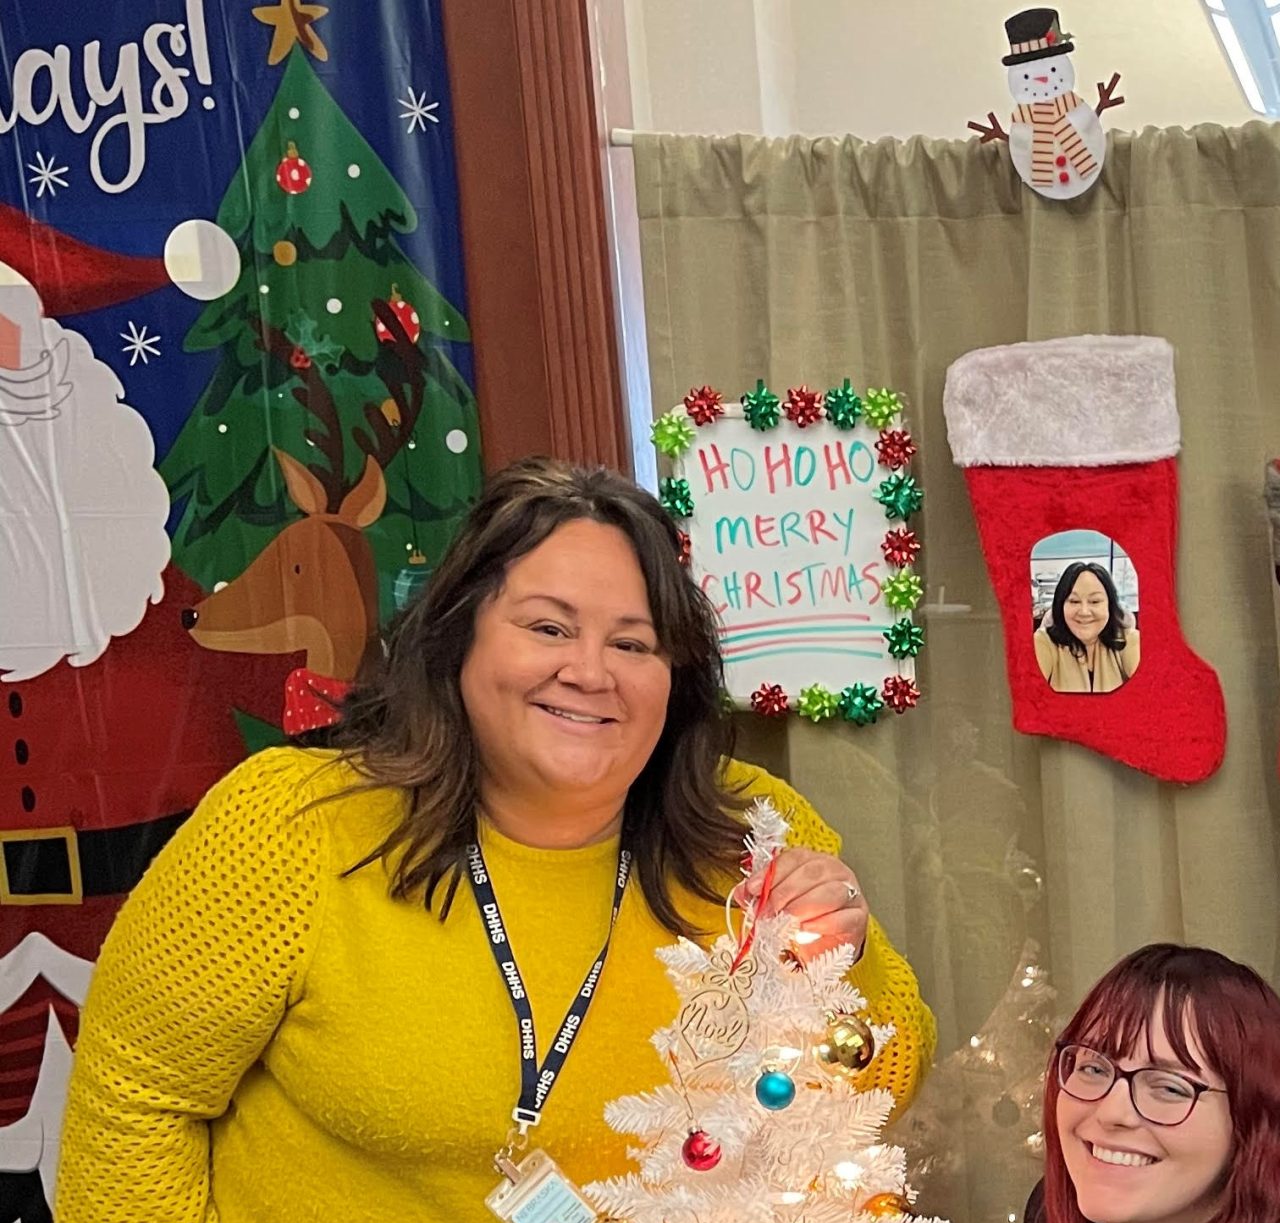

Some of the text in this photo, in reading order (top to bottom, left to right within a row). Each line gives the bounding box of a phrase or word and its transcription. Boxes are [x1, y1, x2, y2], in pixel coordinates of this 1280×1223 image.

[0, 0, 216, 194] ays!
[715, 508, 854, 556] MERRY
[701, 562, 881, 615] CHRISTMAS
[466, 844, 488, 885] DHHS
[617, 849, 632, 889] DHHS
[483, 903, 506, 944] DHHS
[501, 961, 525, 1000] DHHS
[521, 1018, 535, 1060] DHHS
[554, 1014, 581, 1055] DHHS
